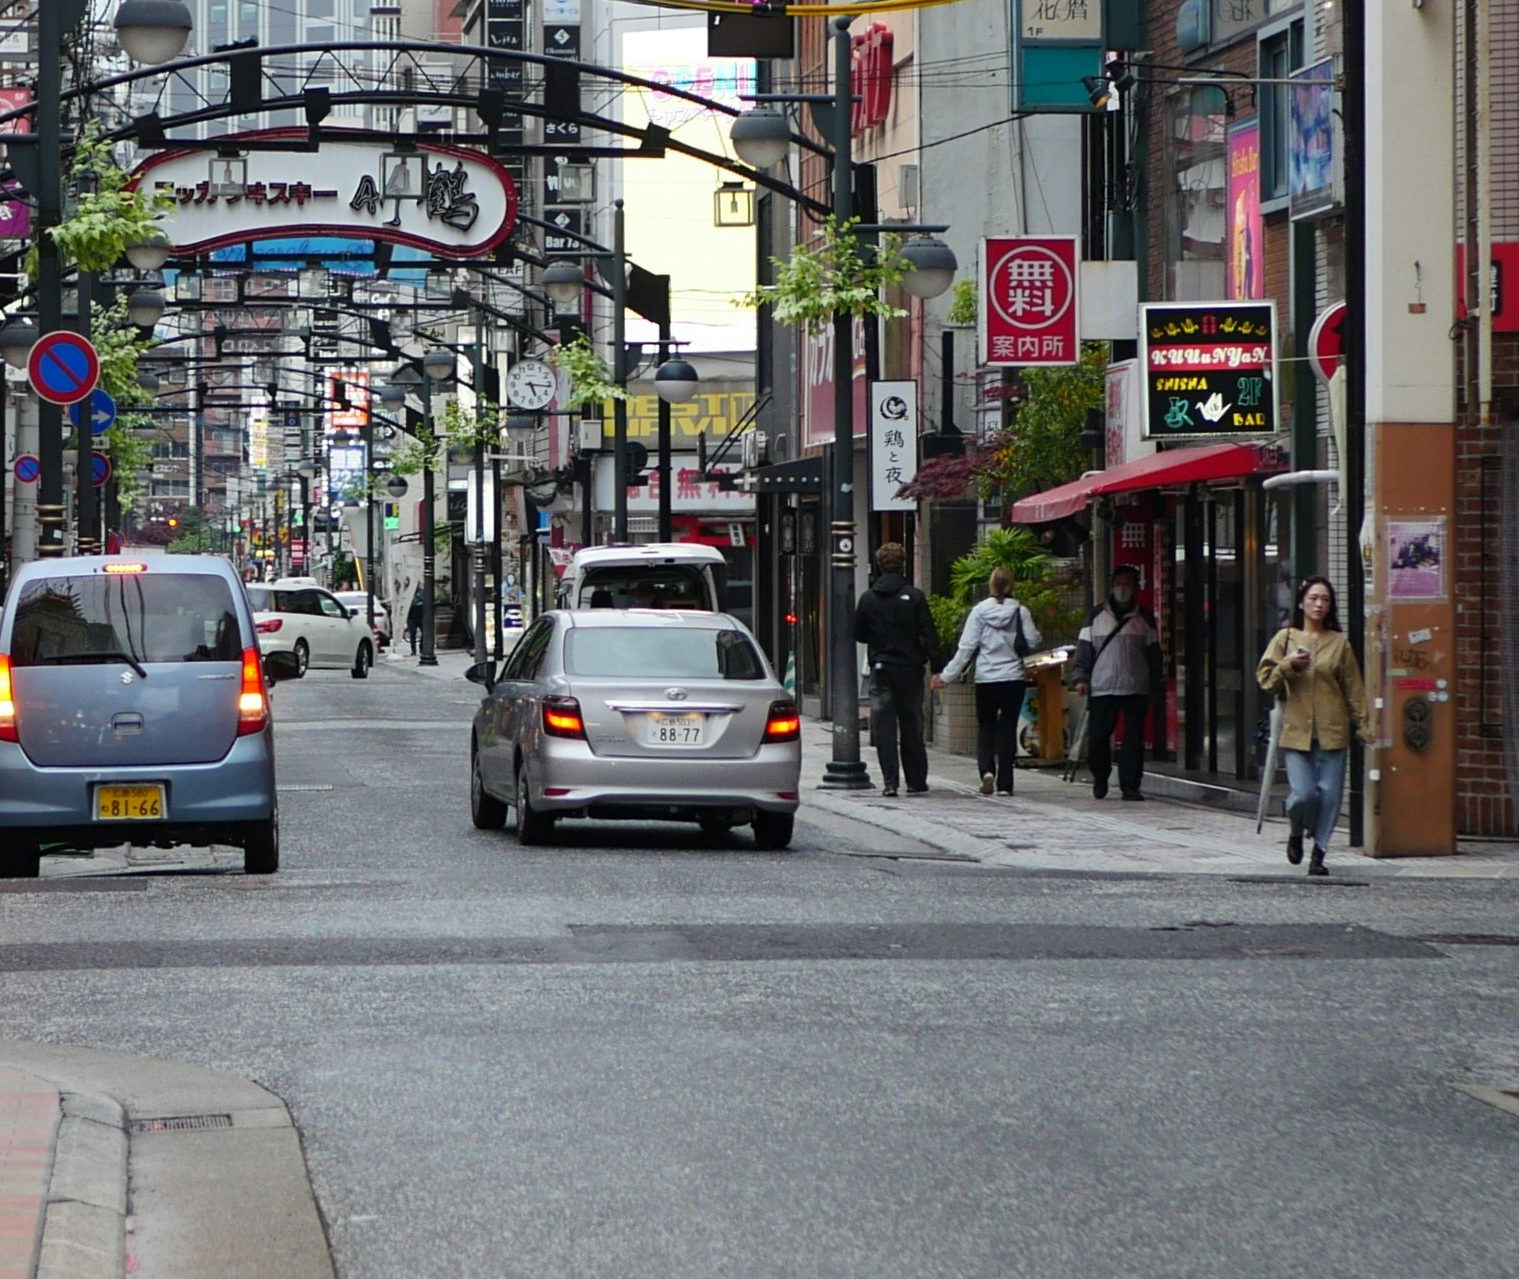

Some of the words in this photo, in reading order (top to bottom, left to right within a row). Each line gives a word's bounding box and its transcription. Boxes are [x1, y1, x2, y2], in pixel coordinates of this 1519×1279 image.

[545, 122, 579, 135] さくら
[545, 236, 565, 249] Bar
[1007, 258, 1055, 317] 無料
[992, 335, 1064, 358] 案内所
[1155, 376, 1209, 391] SHISHA
[1237, 376, 1262, 407] 2F
[883, 429, 906, 486] 鶏と夜
[659, 727, 701, 743] 88-77
[111, 799, 159, 817] 81-66
